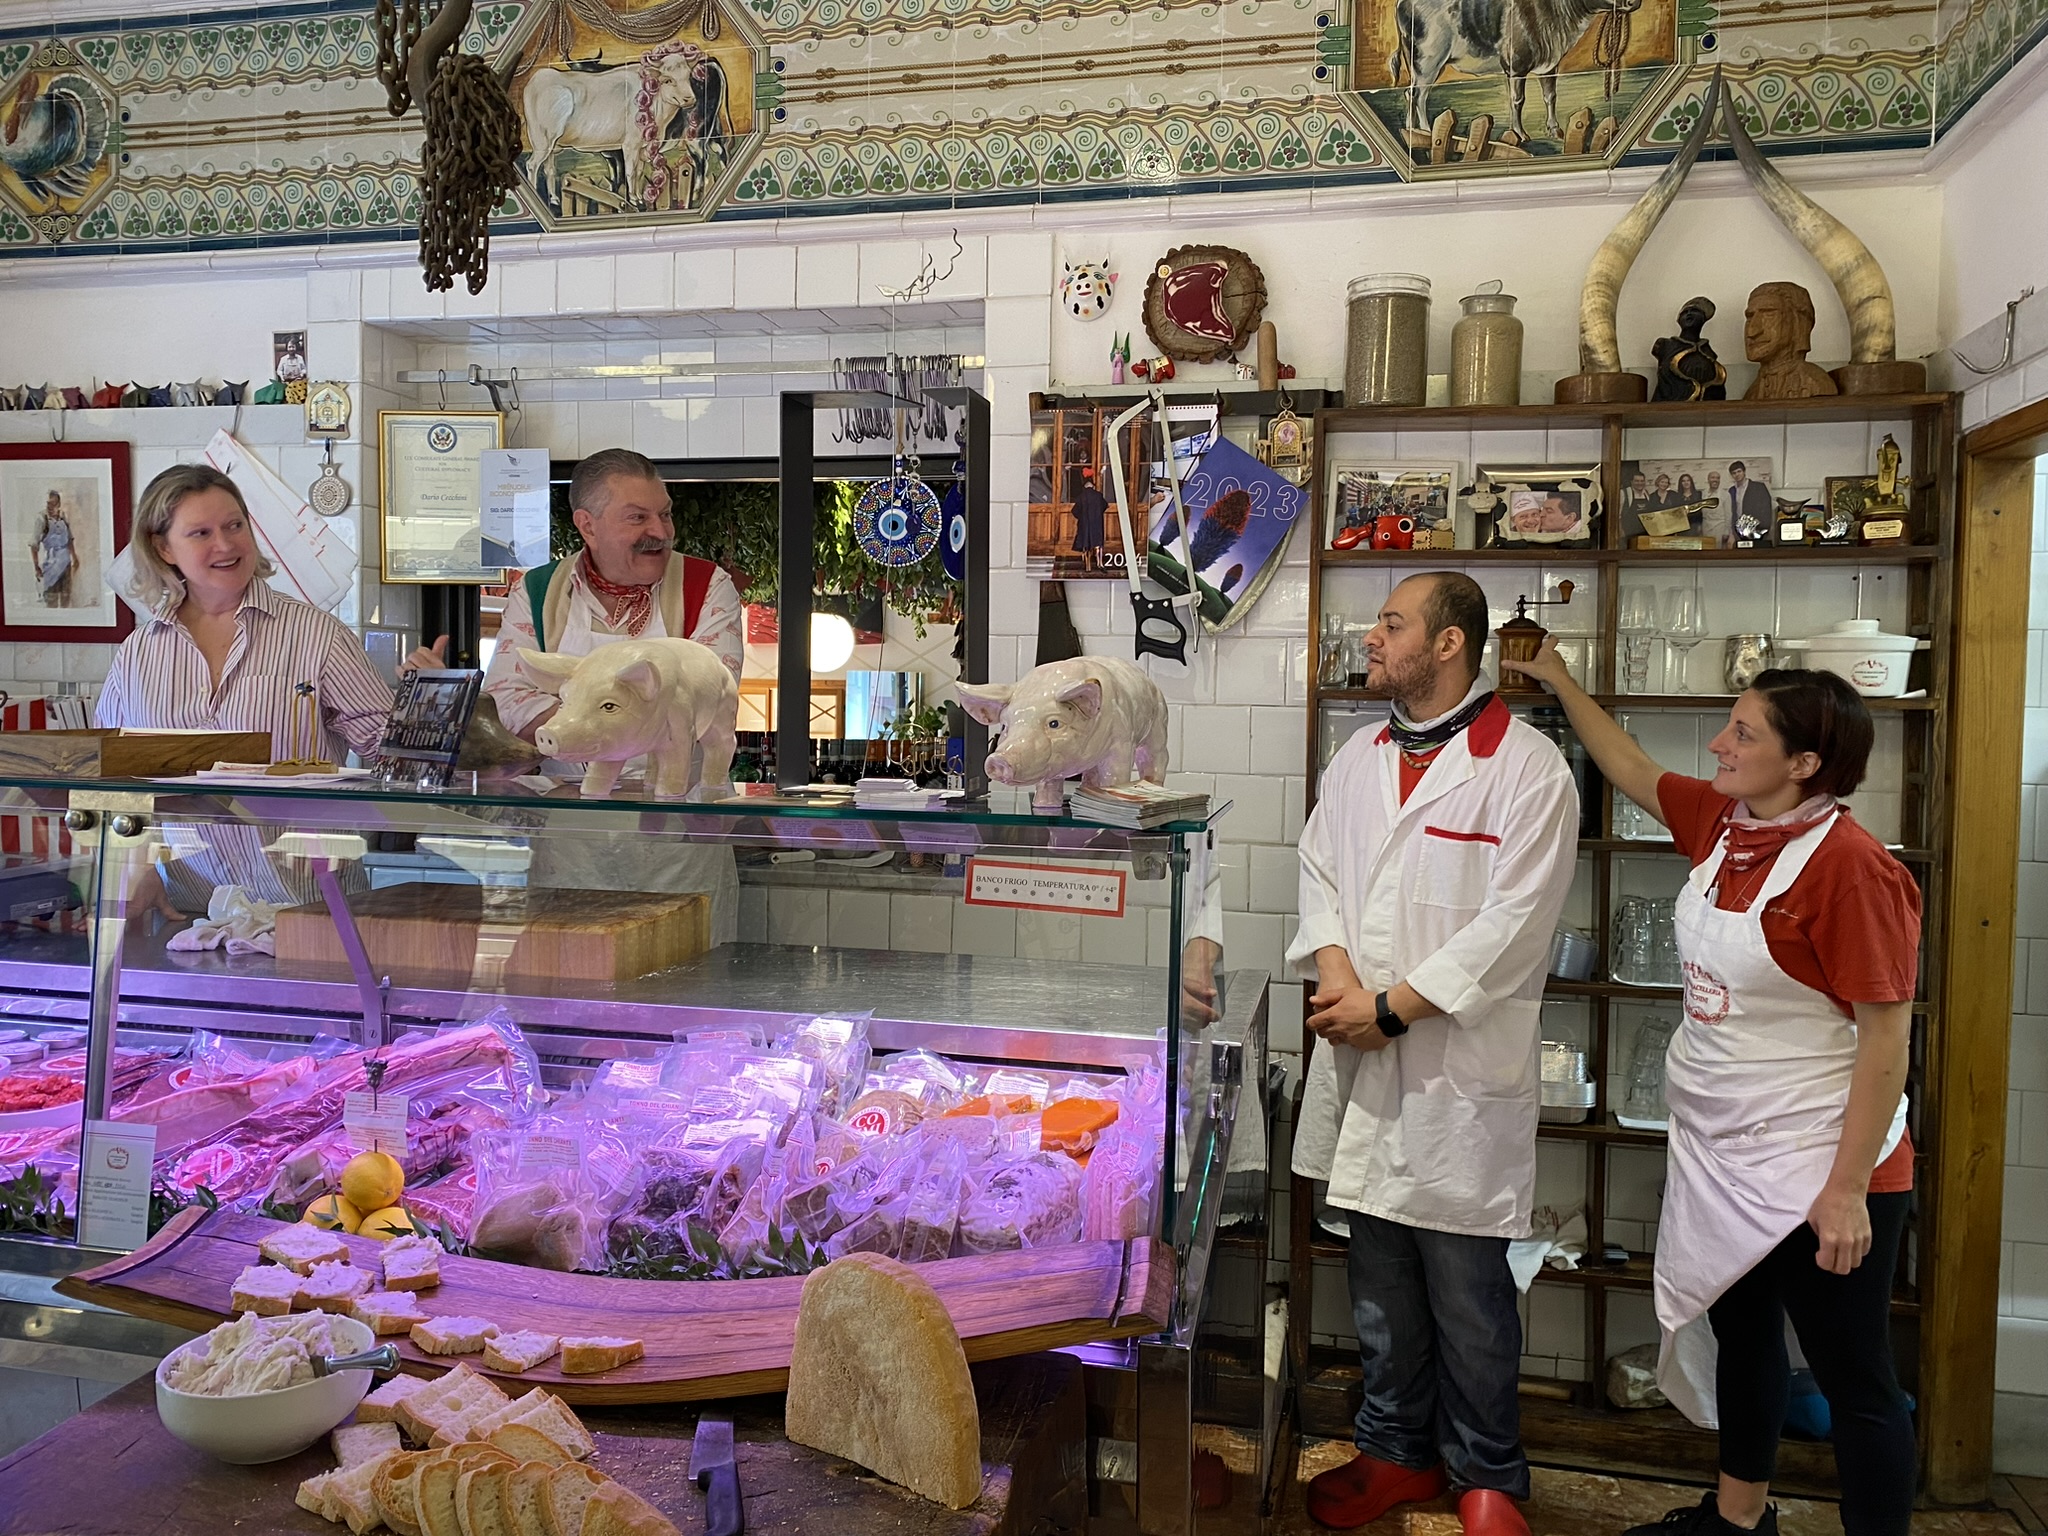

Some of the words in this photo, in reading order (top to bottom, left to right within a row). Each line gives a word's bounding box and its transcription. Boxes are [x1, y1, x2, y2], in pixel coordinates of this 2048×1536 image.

[1104, 553, 1143, 567] 204
[976, 875, 1003, 884] BANCO
[1004, 877, 1028, 886] FRIGO
[1033, 880, 1090, 891] TEMPERATURA
[1091, 884, 1100, 892] 0°
